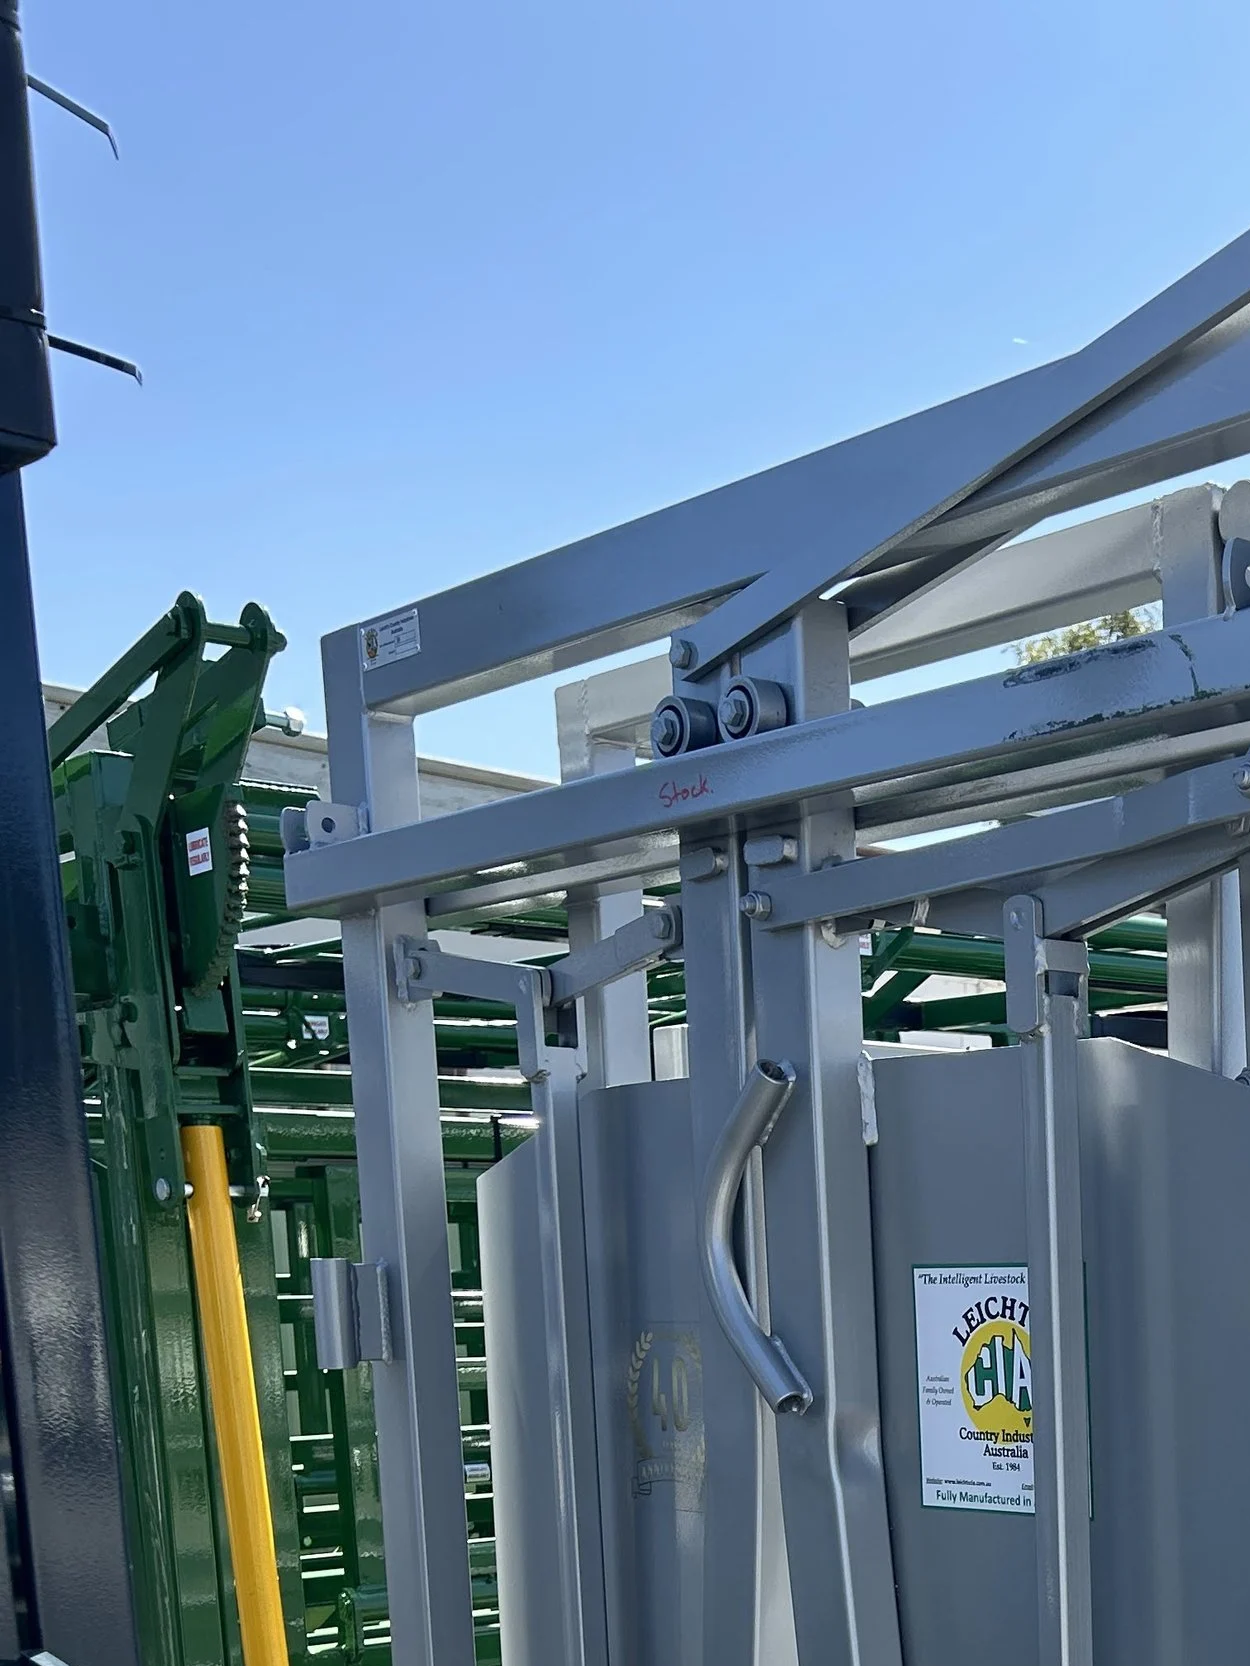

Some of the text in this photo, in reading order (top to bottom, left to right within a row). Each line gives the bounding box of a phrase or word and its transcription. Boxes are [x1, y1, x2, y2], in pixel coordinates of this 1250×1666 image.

[939, 1273, 982, 1288] Intelligent
[984, 1272, 1026, 1285] Livestock
[653, 1357, 688, 1432] 40
[959, 1426, 1000, 1444] Country
[983, 1443, 1029, 1459] Australia
[992, 1461, 1021, 1472] Est. 1984
[936, 1489, 1032, 1507] Fully Manufactured in
